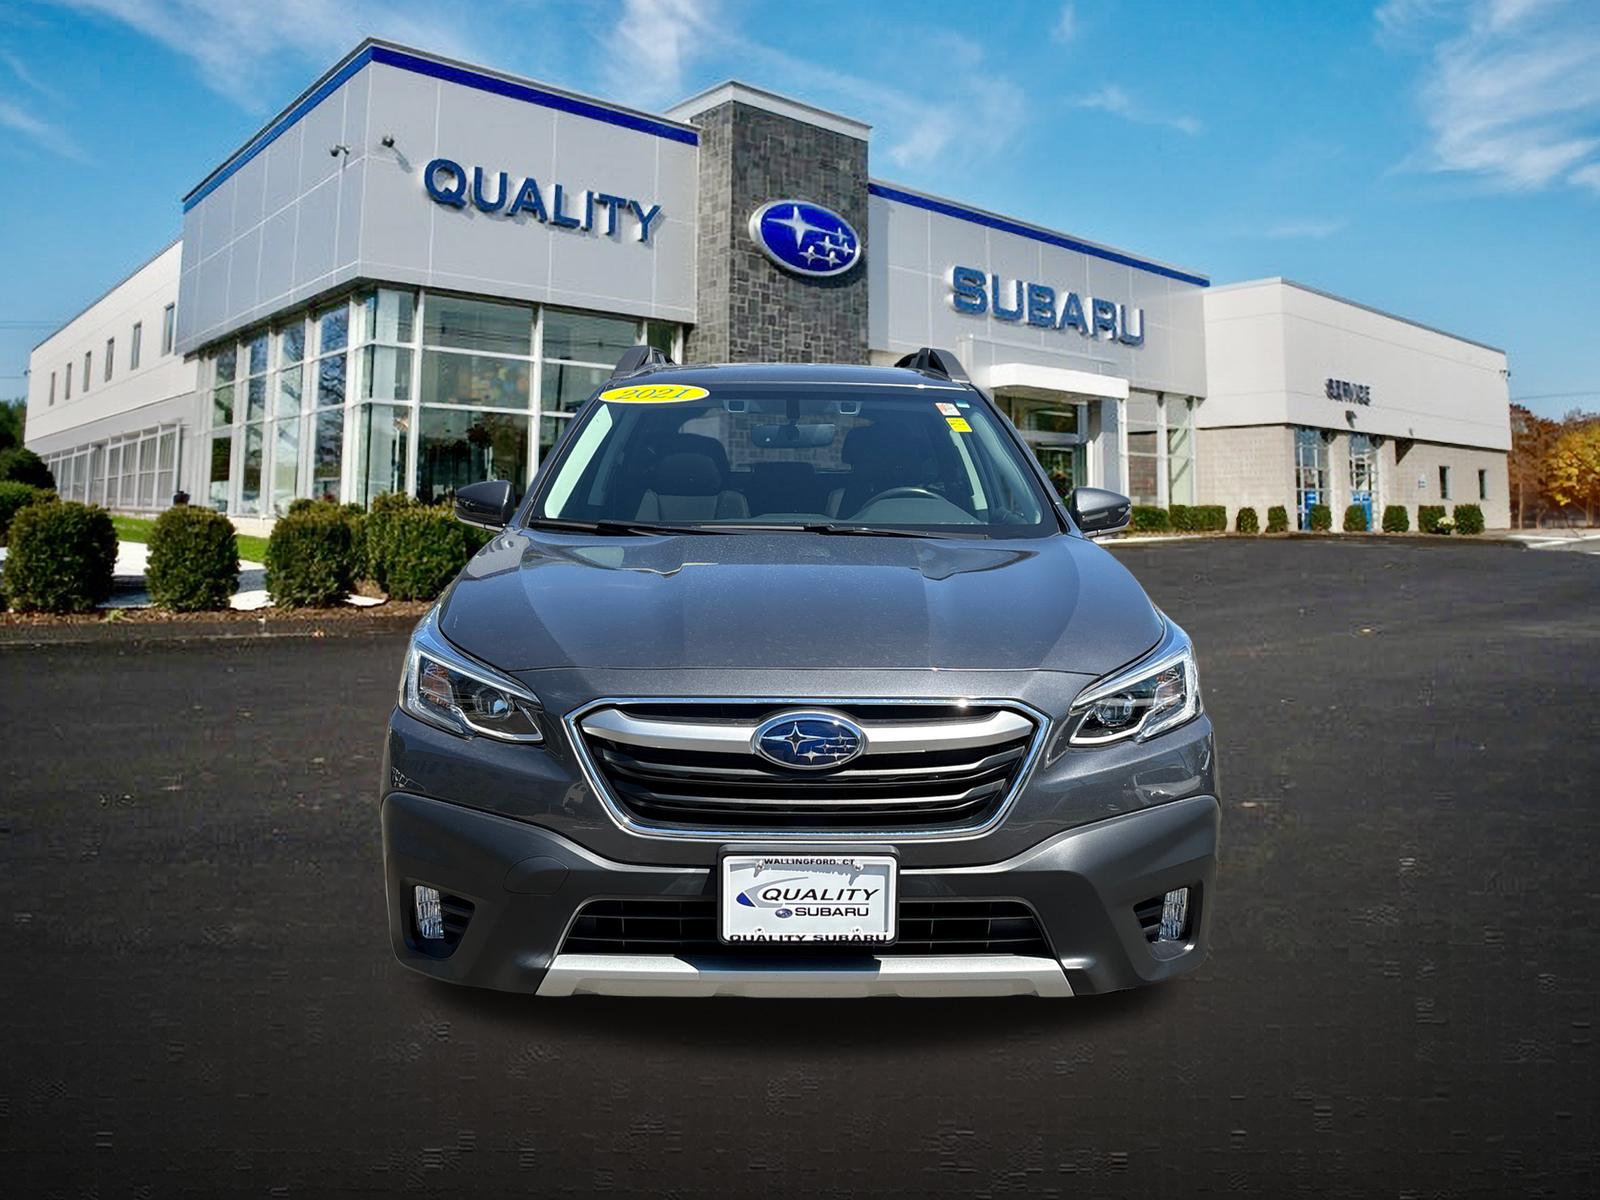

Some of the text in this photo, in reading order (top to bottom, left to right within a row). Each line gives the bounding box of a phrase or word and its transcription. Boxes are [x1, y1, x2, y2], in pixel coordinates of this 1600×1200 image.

[423, 158, 662, 243] QUALITY
[950, 265, 1145, 347] SUBARU
[615, 388, 691, 400] 2021
[762, 888, 880, 901] QUALITY
[795, 907, 869, 917] SUBARU
[729, 934, 888, 943] QUALITY SUBARU
